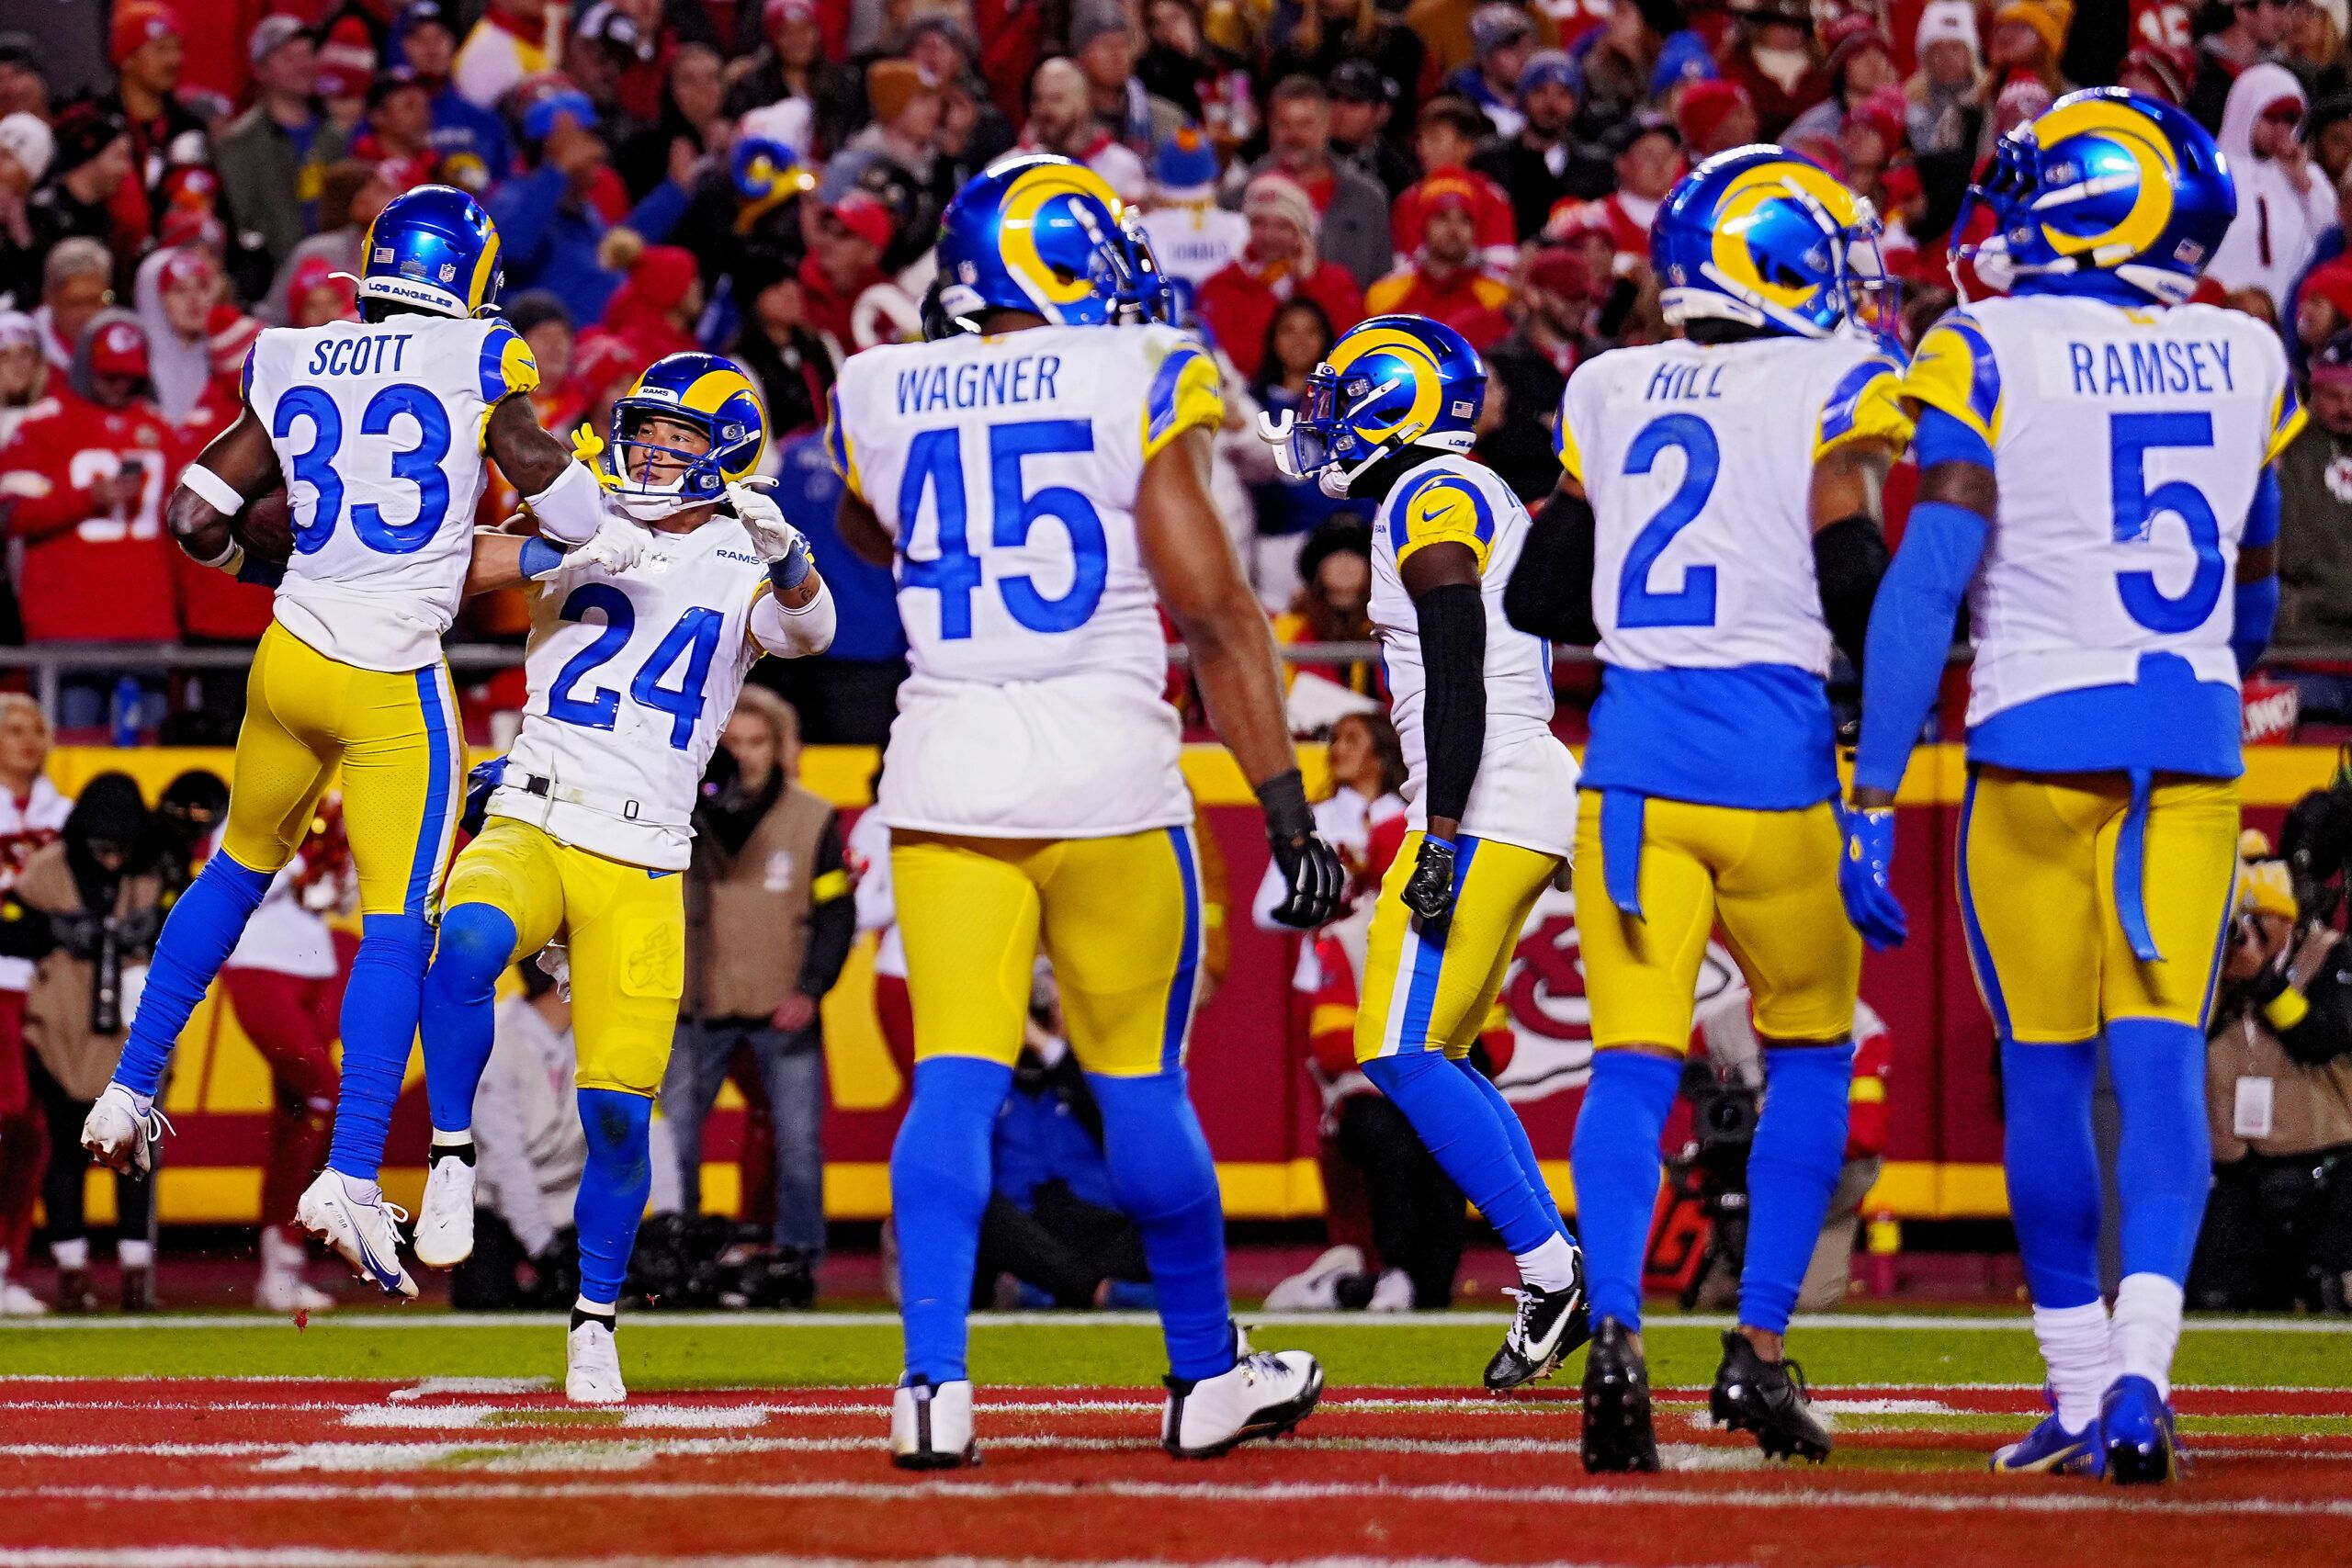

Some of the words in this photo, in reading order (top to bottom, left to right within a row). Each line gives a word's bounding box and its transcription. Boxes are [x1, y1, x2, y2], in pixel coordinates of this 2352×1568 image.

[368, 282, 390, 292] LOS
[391, 287, 453, 309] ANGELES
[307, 333, 413, 377] SCOTT
[1645, 362, 1725, 400] HILL
[2067, 340, 2235, 396] RAMSEY
[642, 388, 669, 397] RAMS
[897, 355, 1061, 414] WAGNER
[272, 383, 452, 556] 33
[897, 417, 1110, 641] 45
[1615, 411, 1722, 630] 2
[2109, 410, 2228, 636] 5
[716, 548, 761, 566] RAMS
[547, 583, 725, 751] 24
